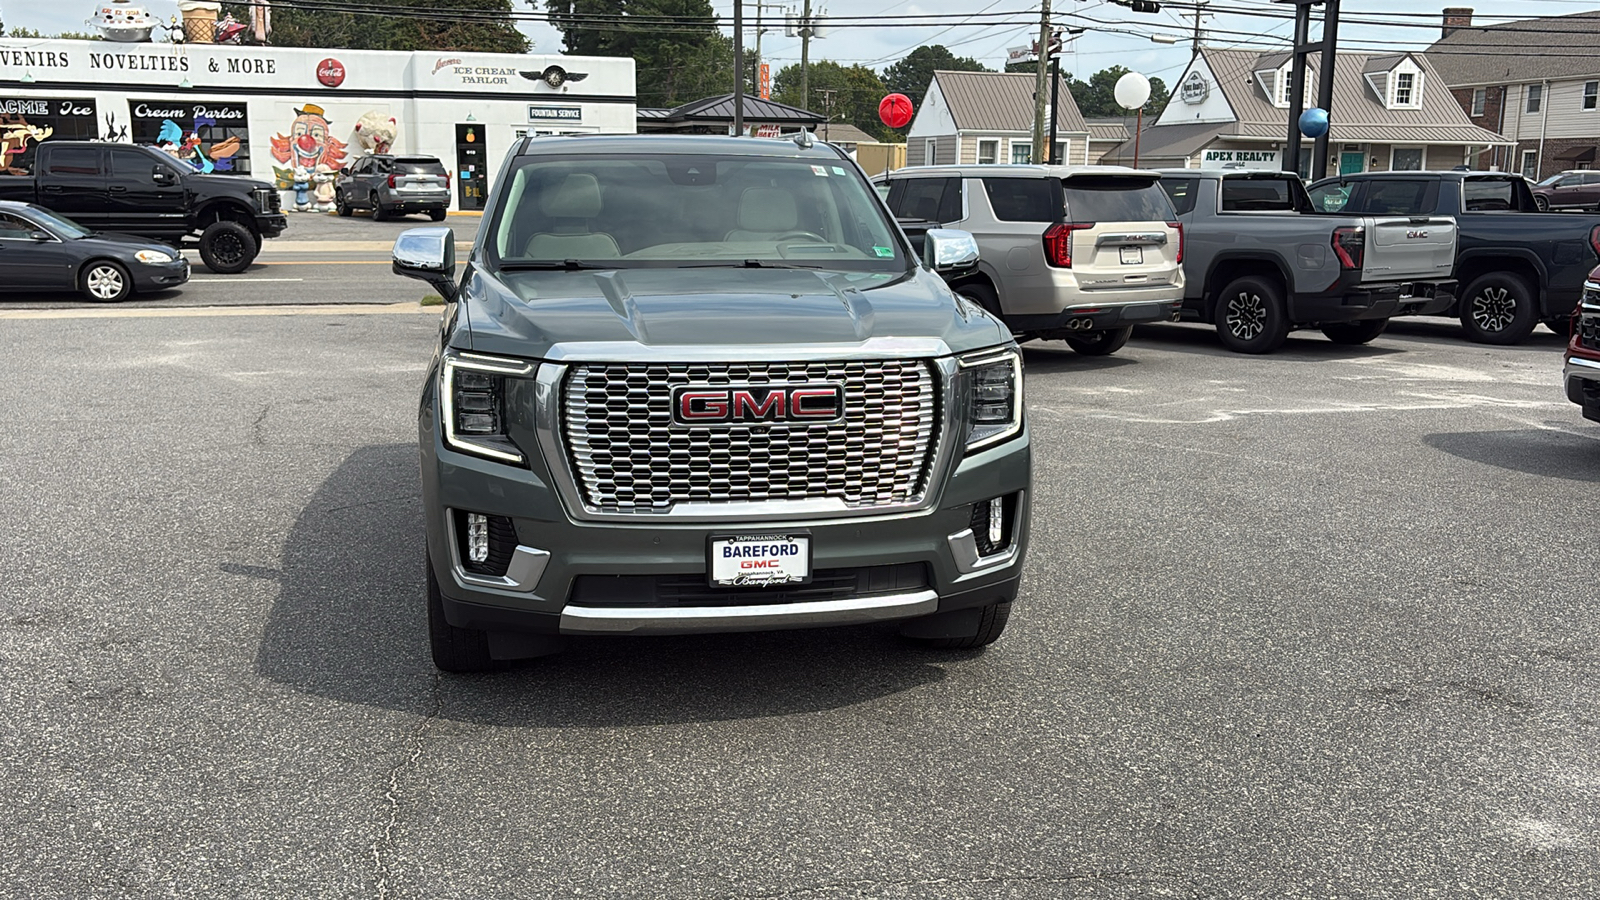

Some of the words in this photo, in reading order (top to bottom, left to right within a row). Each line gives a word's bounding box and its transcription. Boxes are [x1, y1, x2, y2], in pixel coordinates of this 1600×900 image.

[89, 53, 189, 72] NOVELTIES
[208, 57, 219, 73] &
[227, 58, 276, 74] MORE
[454, 66, 472, 75] ICE
[475, 67, 516, 76] CREAM
[462, 76, 508, 85] PARLOR
[59, 101, 94, 116] Ice
[134, 103, 187, 118] Cream
[192, 105, 245, 120] Parlor
[531, 108, 557, 118] FOUNTAIN
[558, 109, 580, 118] SERVICE
[1205, 151, 1233, 161] APEX
[1236, 152, 1276, 162] REALTY
[1406, 230, 1428, 239] GMC
[680, 389, 837, 420] GMC
[723, 543, 799, 558] BAREFORD
[740, 559, 780, 569] GMC
[733, 574, 791, 588] Bareford
